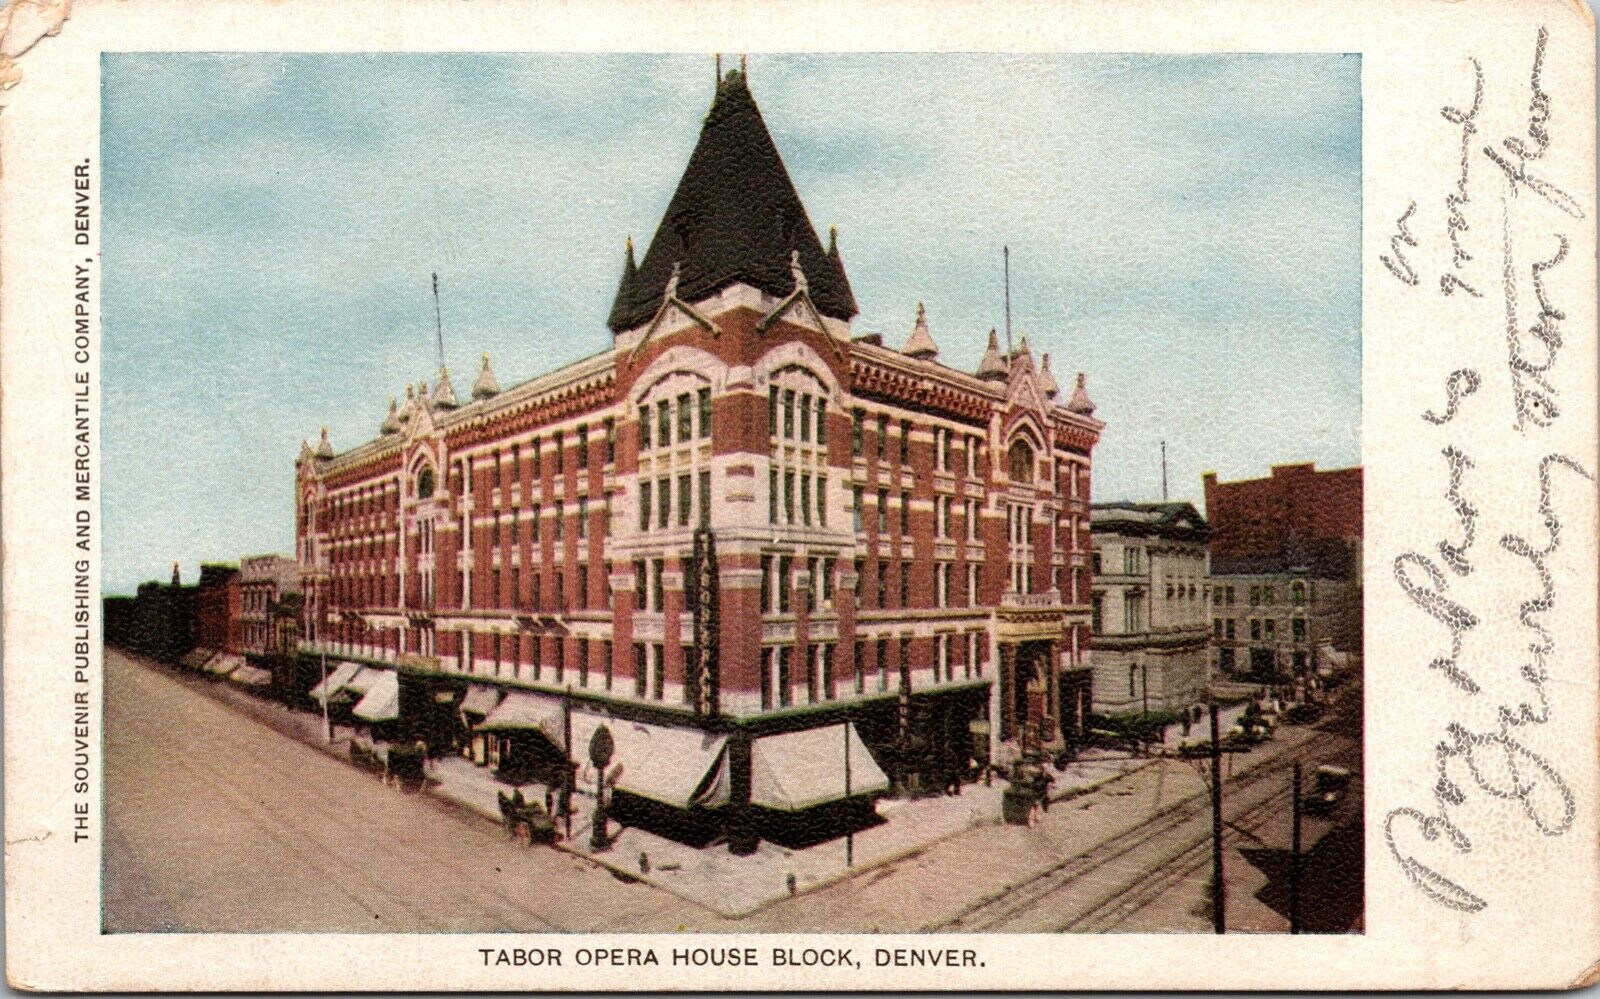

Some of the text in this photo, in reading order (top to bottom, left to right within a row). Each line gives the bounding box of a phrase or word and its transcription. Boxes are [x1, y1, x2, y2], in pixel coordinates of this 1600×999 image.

[74, 158, 93, 843] THE SOUVENIR PUBLISHING AND MERCANTILE COMPANY, DENVER.
[478, 948, 986, 970] TABOR OPERA HOUSE BLOCK, DENVER.
